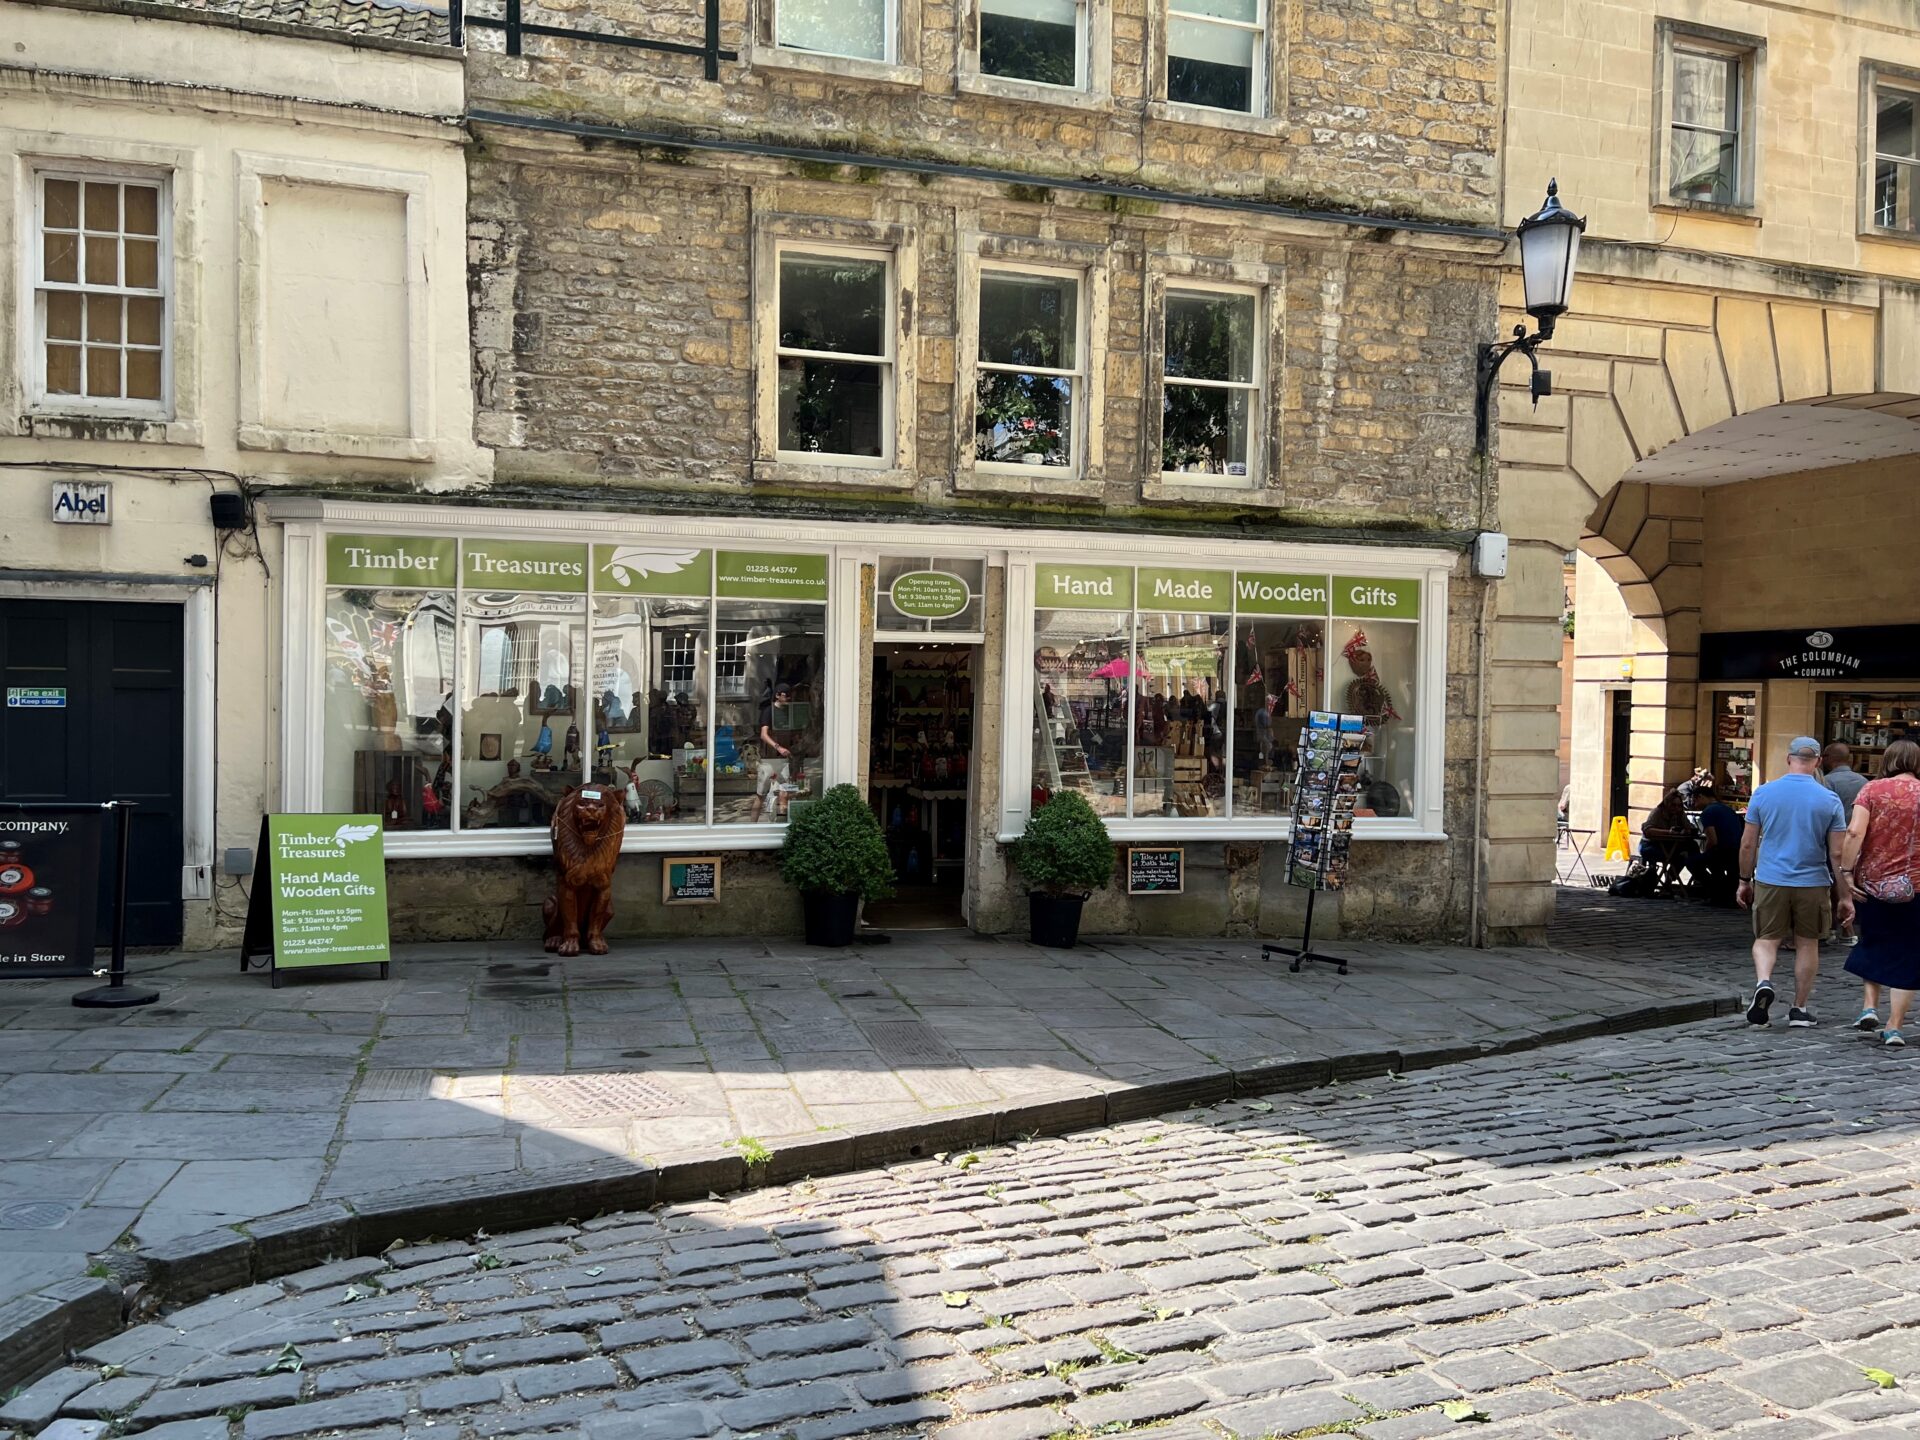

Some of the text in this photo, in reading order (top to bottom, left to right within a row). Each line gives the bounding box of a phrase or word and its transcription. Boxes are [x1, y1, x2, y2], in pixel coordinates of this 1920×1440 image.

[55, 491, 106, 513] Abel
[345, 547, 582, 575] Timber Treasures
[746, 564, 797, 574] 01225 443747
[719, 575, 826, 586] www.timber-treasures.co.uk
[908, 578, 934, 586] Opening
[1053, 575, 1397, 606] Hand Made Wooden Gifts
[941, 602, 954, 610] 4pm
[1780, 651, 1860, 670] THE COLOMBIAN
[1801, 668, 1836, 677] COMPANY
[22, 689, 59, 697] Fire exit
[21, 698, 40, 706] Keep
[278, 832, 331, 845] Timber
[278, 846, 346, 858] Treasures
[280, 871, 360, 884] Hand Made
[281, 884, 376, 898] Wooden Gifts
[315, 908, 335, 916] 10am
[345, 908, 363, 916] 5pm
[335, 915, 363, 924] 5.30pm
[331, 924, 348, 932] 4pm
[283, 938, 334, 947] 01225 443747
[283, 943, 386, 955] www.timber-treasures.co.uk
[13, 953, 27, 963] in
[30, 953, 66, 963] Store
